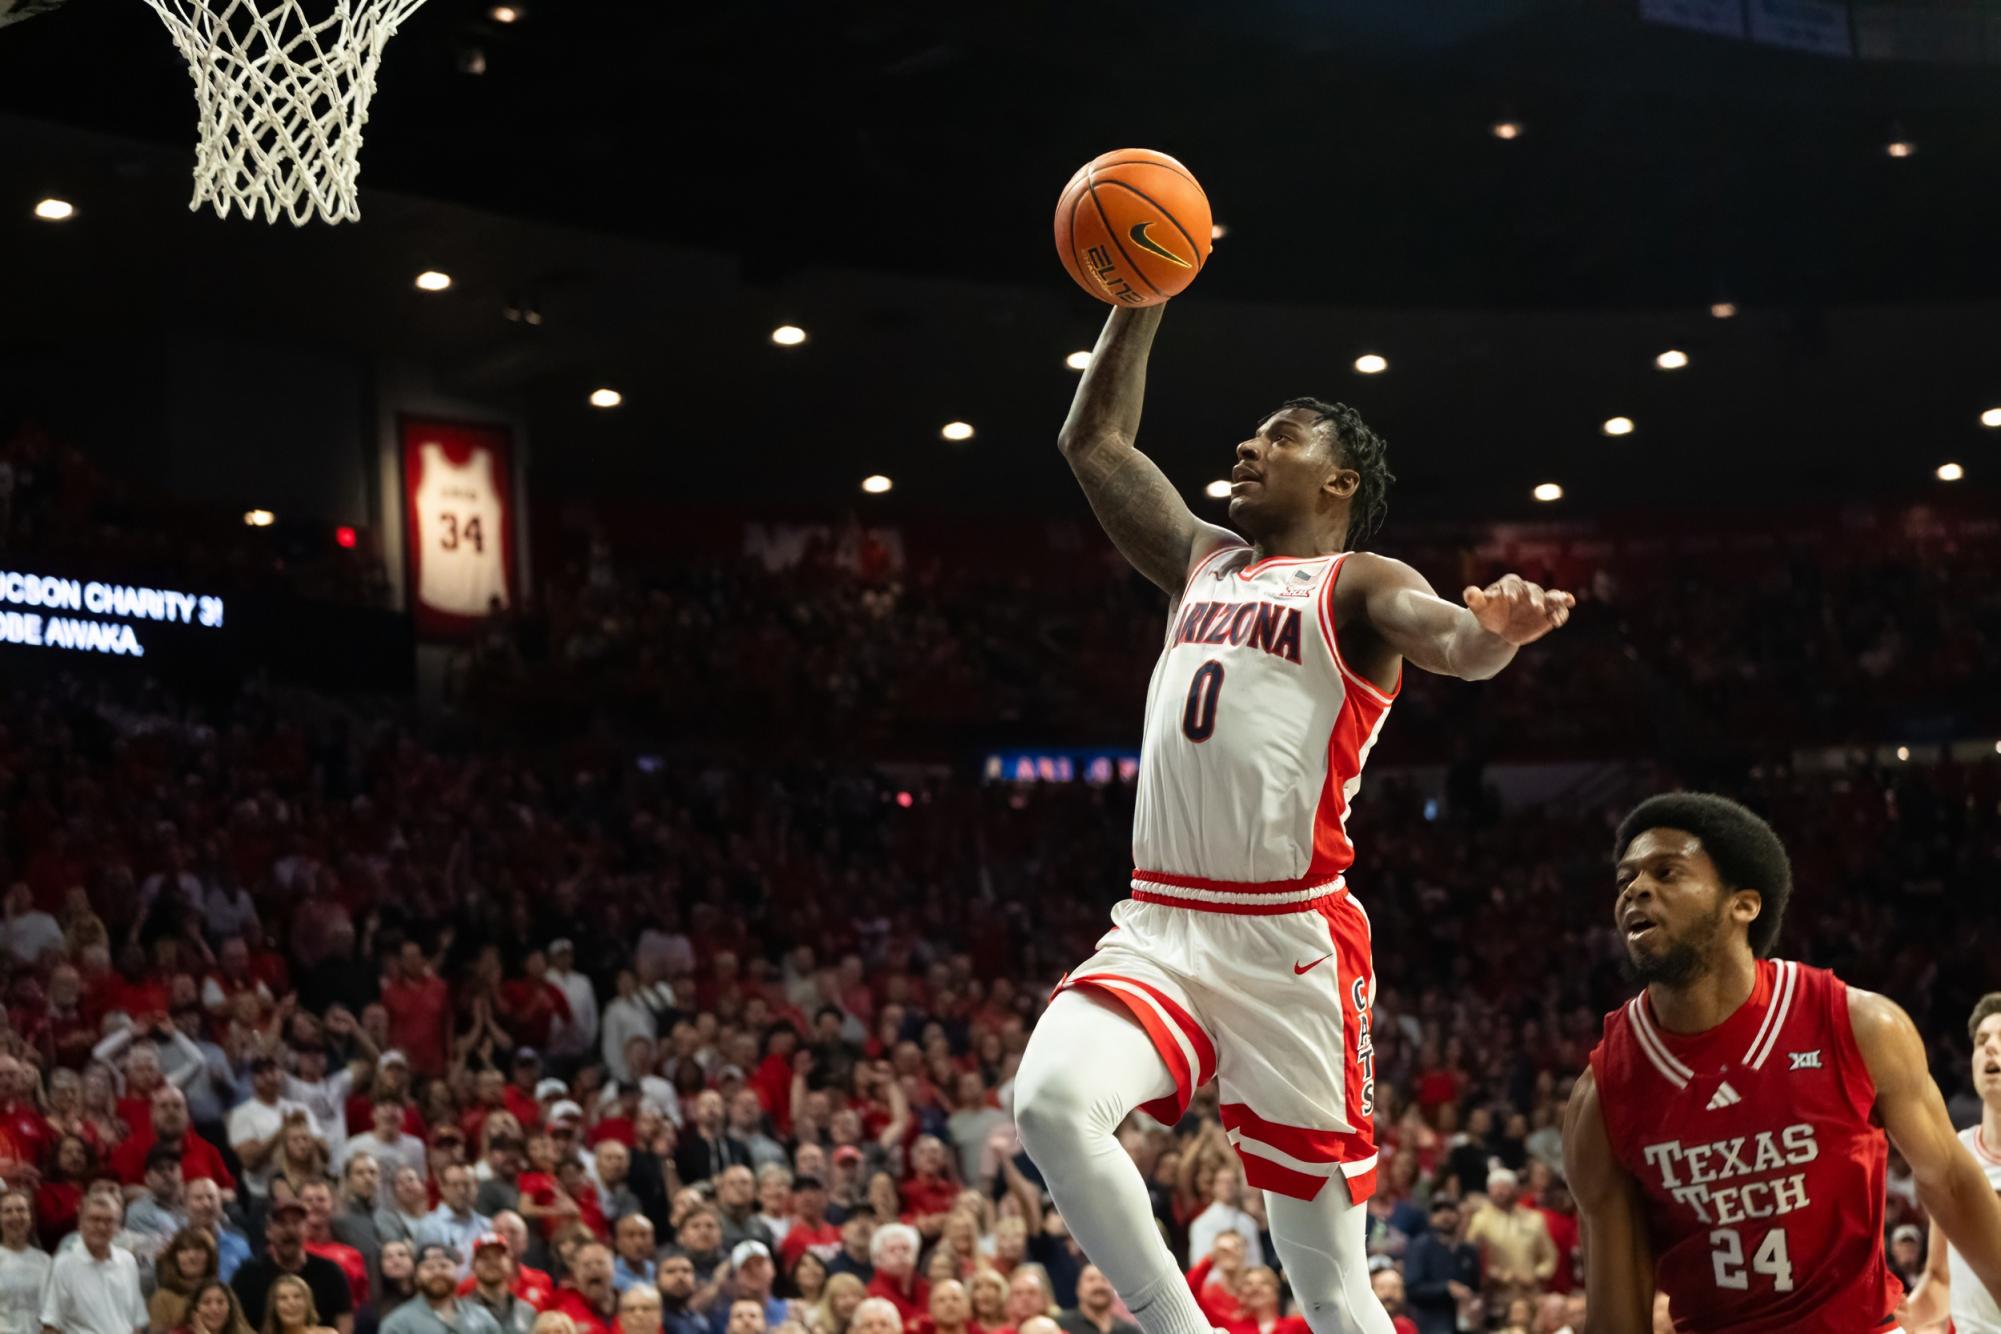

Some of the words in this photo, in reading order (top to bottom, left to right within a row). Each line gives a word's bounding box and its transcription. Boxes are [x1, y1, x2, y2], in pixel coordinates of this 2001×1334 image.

[1087, 245, 1145, 304] ELITE
[440, 512, 483, 553] 34
[84, 581, 196, 624] CHARITY
[1171, 601, 1302, 666] ARIZONA
[1183, 659, 1225, 743] 0
[1352, 976, 1375, 1116] CATS
[1709, 1228, 1794, 1292] 24
